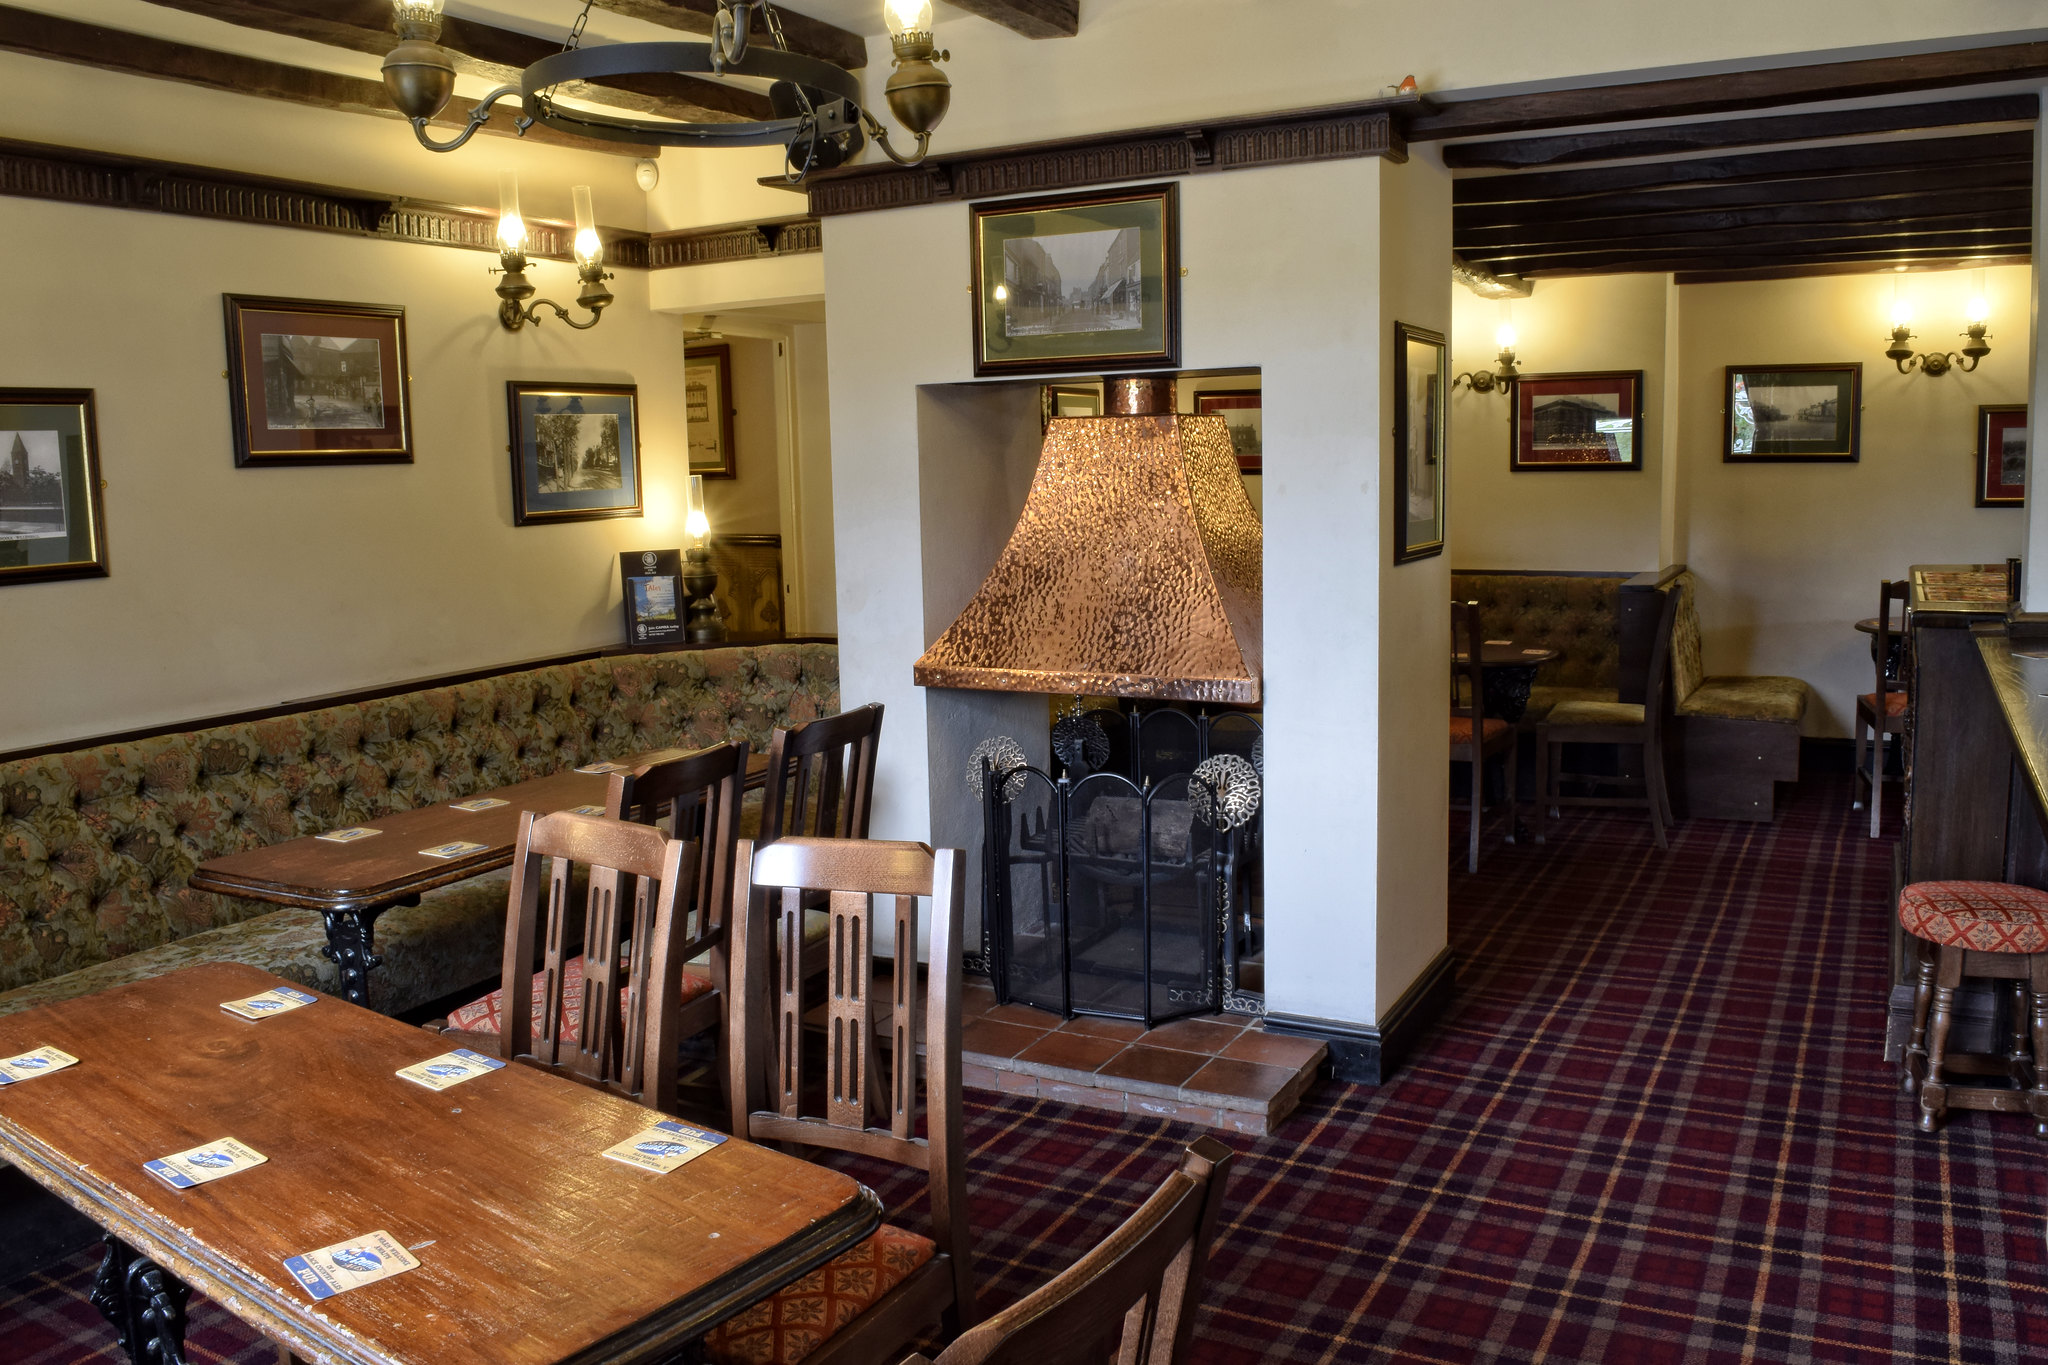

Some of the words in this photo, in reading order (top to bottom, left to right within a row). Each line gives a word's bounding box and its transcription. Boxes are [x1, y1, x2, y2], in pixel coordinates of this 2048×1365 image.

[679, 1127, 705, 1137] PUB
[158, 1167, 179, 1178] PUB
[297, 1267, 320, 1285] PUB
